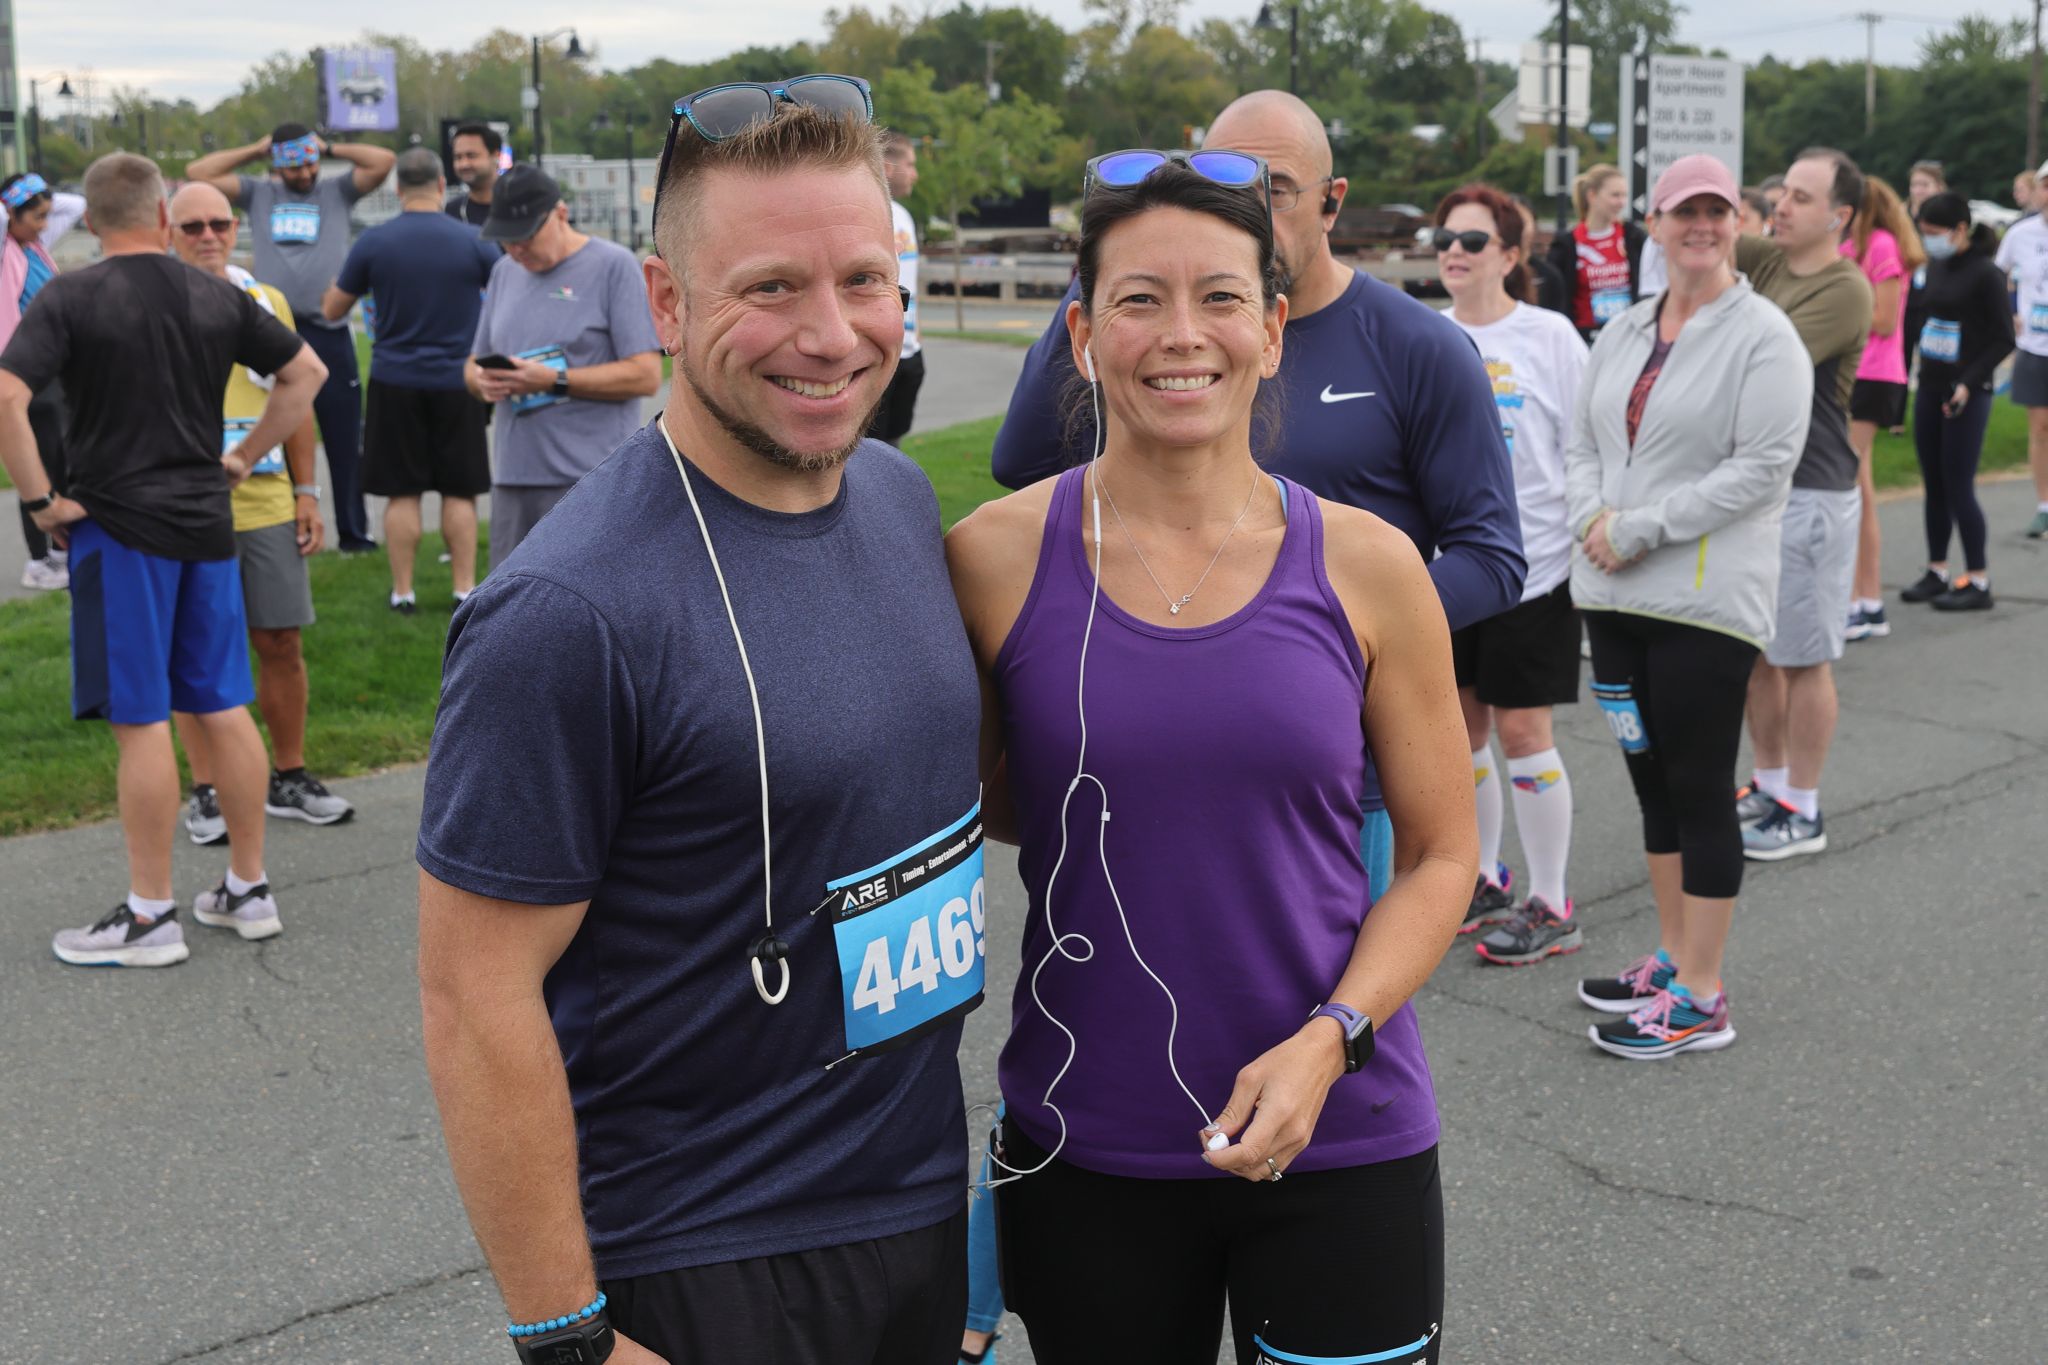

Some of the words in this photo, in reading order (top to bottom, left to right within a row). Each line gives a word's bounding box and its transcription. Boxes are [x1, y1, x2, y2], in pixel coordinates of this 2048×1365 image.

[1656, 65, 1684, 79] River
[1688, 66, 1726, 80] House
[1655, 82, 1727, 98] Apartments
[1655, 128, 1717, 143] Harborside
[1585, 262, 1630, 279] Tropical
[841, 876, 888, 911] ARE
[901, 865, 925, 883] Timing
[928, 839, 968, 870] Entertainment
[857, 894, 889, 911] PRODUCTIONS
[852, 877, 985, 1015] 4469
